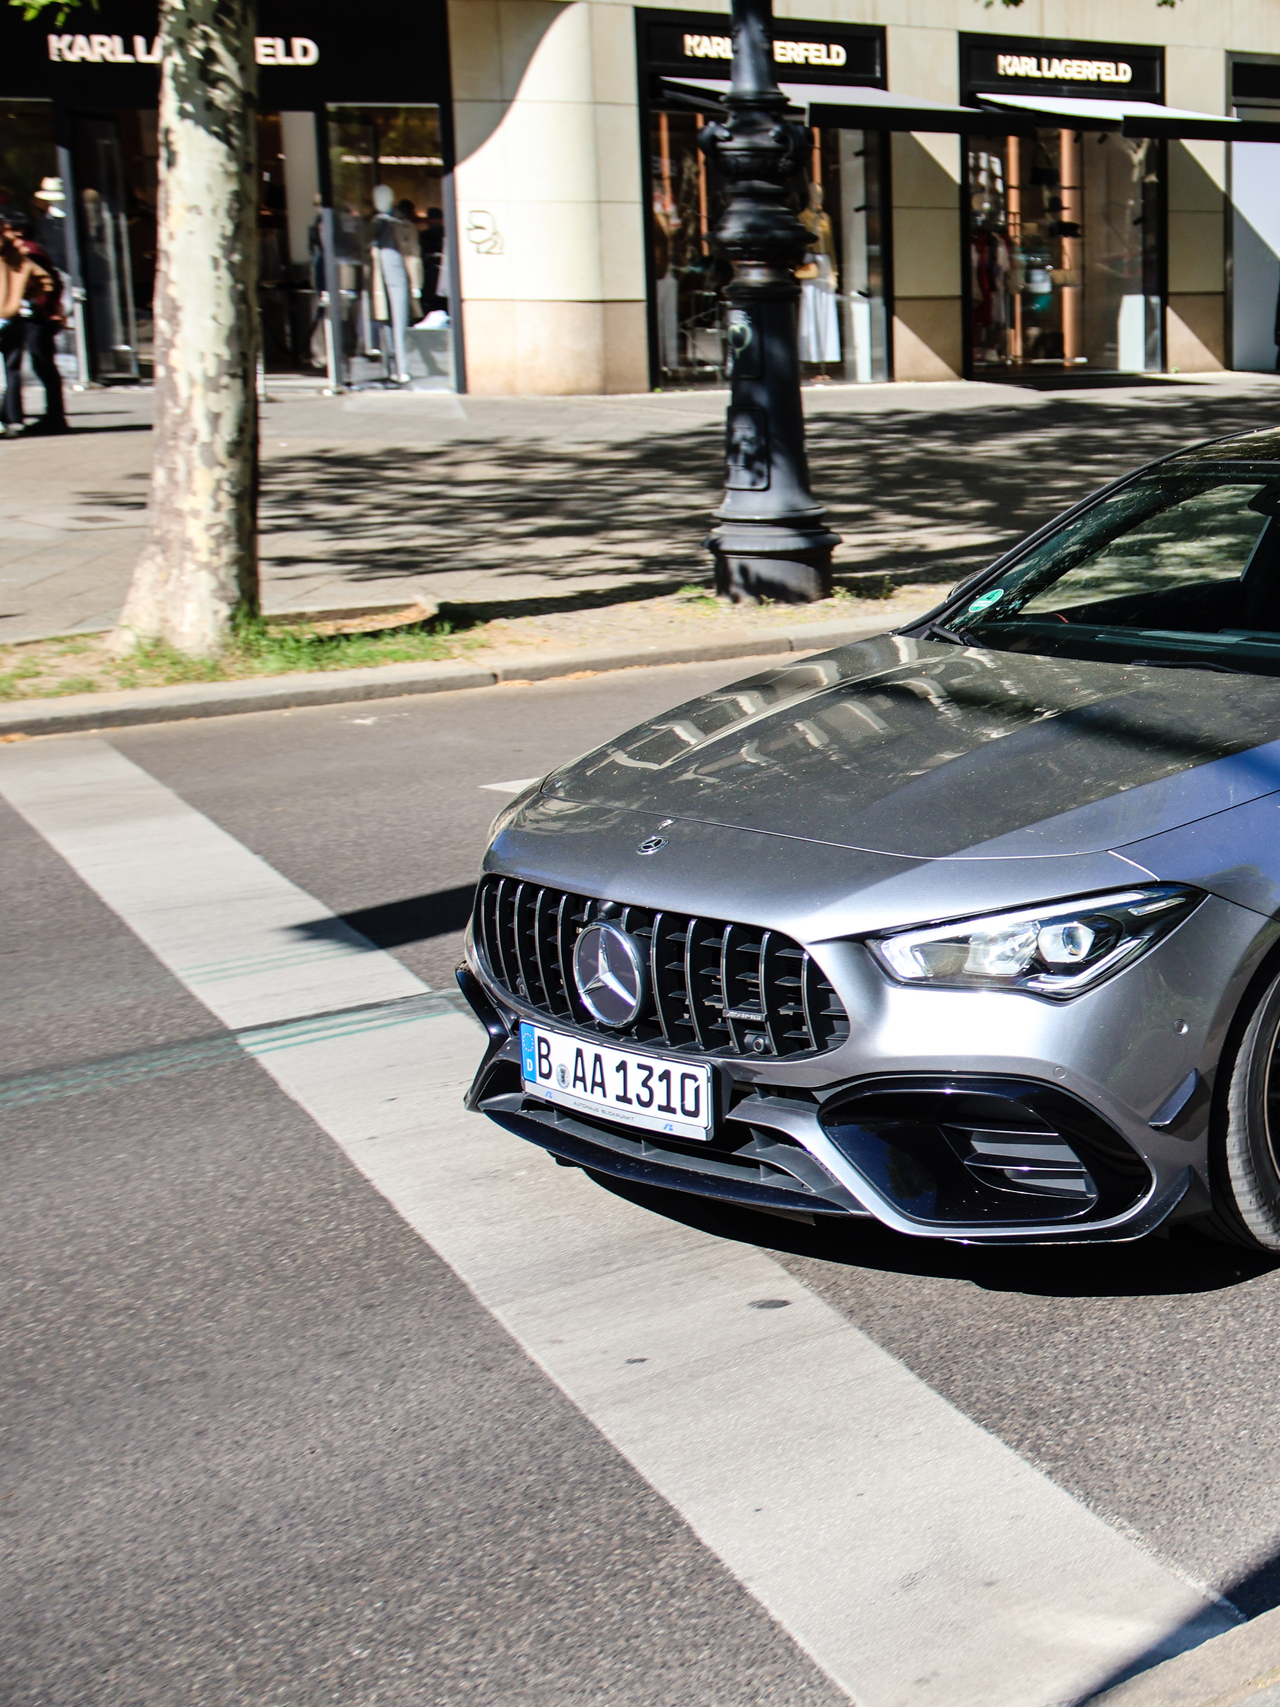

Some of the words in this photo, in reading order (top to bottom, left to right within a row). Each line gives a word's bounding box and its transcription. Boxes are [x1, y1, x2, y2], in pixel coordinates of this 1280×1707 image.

[47, 34, 136, 63] KARL
[683, 34, 734, 59] KARL
[772, 40, 847, 66] ERFELD
[997, 54, 1042, 78] KARL
[1041, 57, 1132, 83] LAGERFELD
[526, 1059, 533, 1072] D
[537, 1035, 553, 1080] B
[572, 1047, 607, 1099] AA
[615, 1059, 701, 1119] 1310
[573, 1100, 600, 1113] AUTOHAUS
